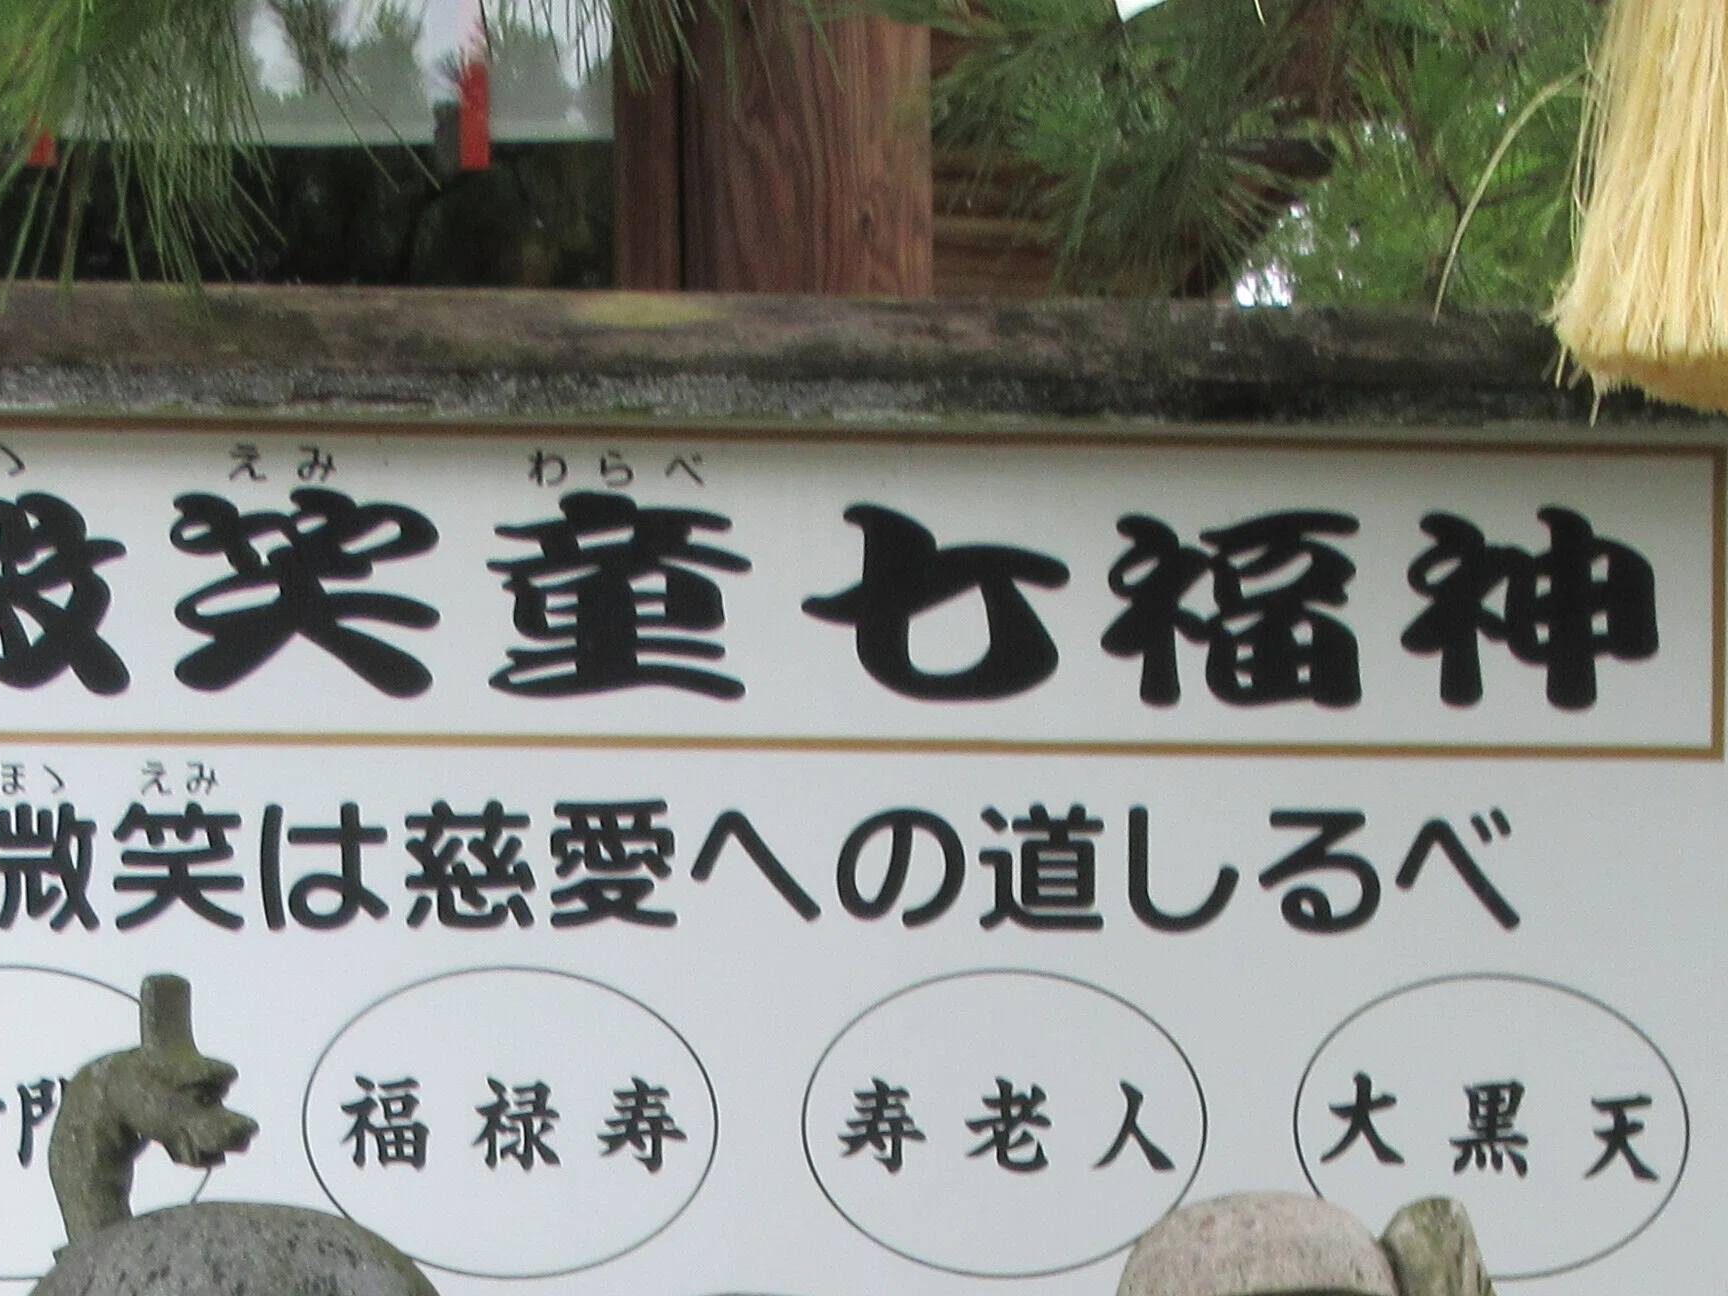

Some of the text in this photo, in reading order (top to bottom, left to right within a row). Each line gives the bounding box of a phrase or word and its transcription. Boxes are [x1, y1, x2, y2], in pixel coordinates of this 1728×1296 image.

[338, 1075, 689, 1176] 福禄寿
[839, 1077, 1178, 1176] 寿老人
[1319, 1071, 1661, 1184] 大黒天
